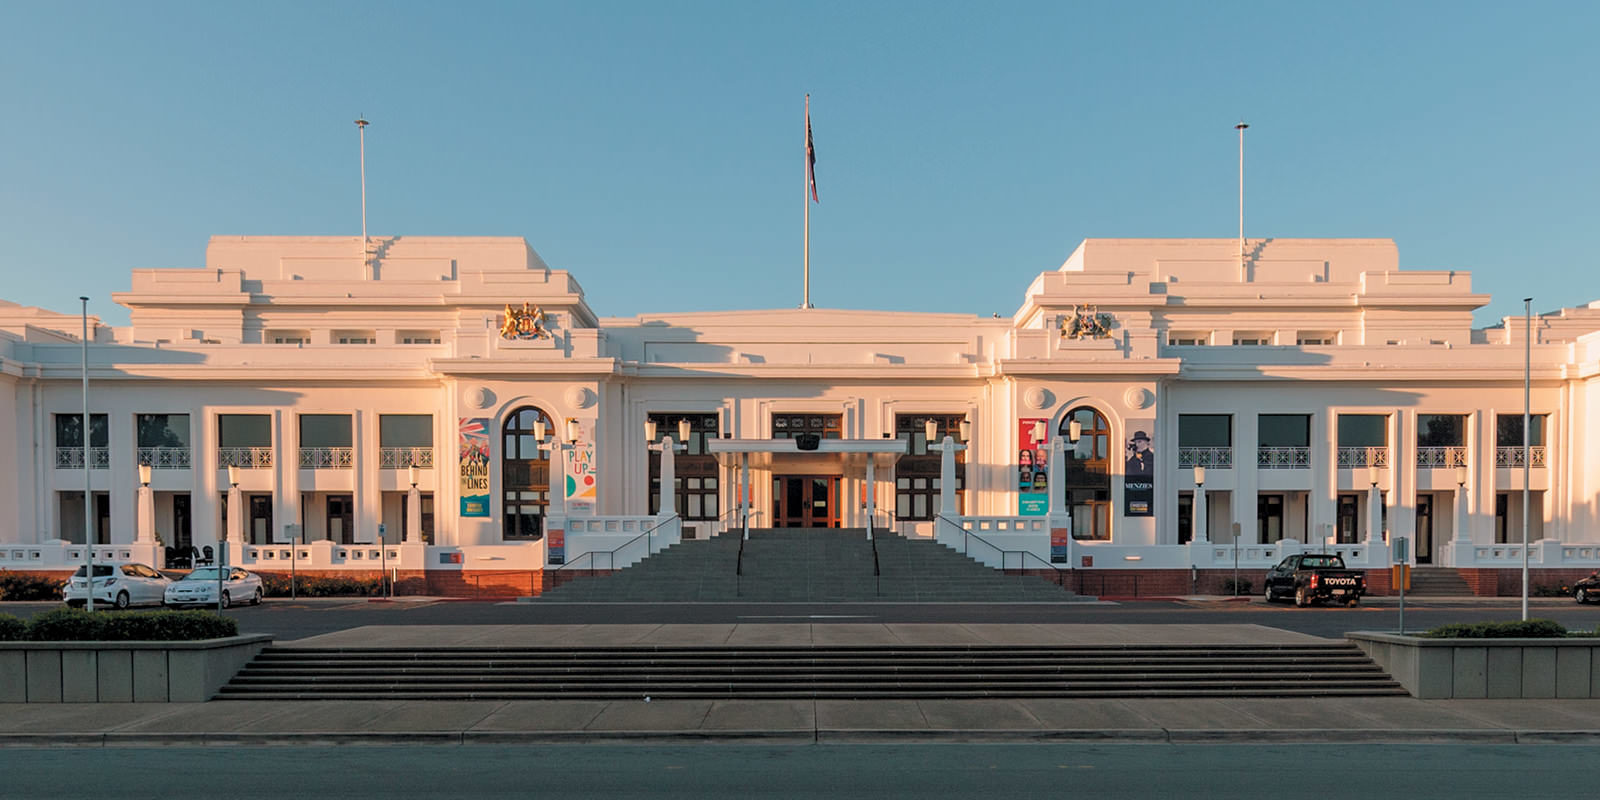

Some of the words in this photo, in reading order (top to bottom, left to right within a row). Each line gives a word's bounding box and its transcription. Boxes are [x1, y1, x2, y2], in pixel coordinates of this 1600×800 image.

[569, 450, 592, 463] PLAY
[461, 465, 488, 476] BEHIND
[574, 464, 588, 475] UP
[467, 478, 488, 489] LINES
